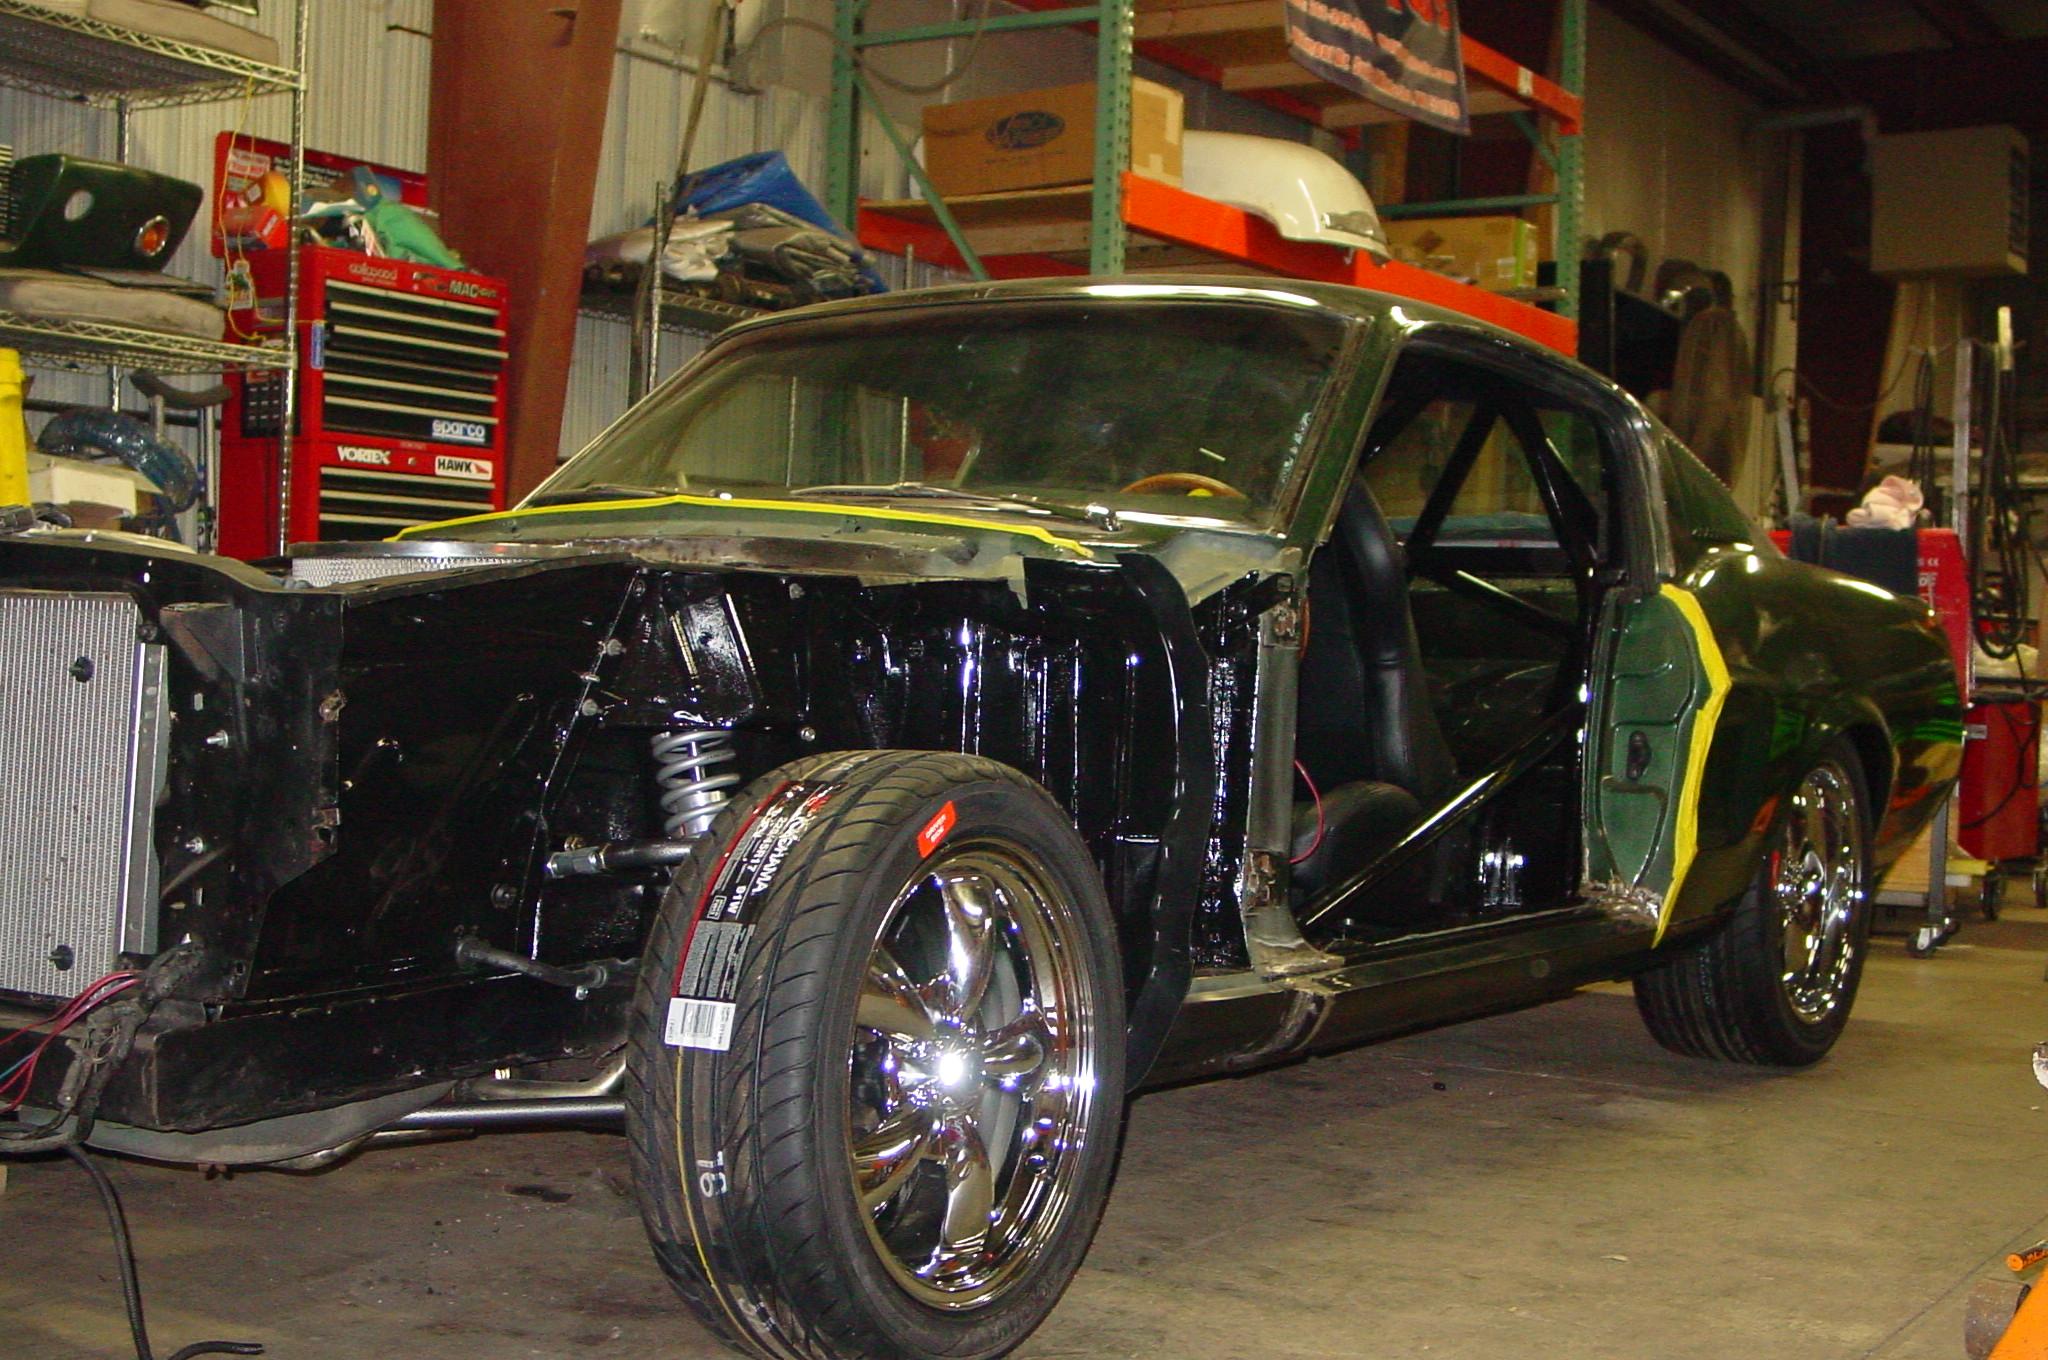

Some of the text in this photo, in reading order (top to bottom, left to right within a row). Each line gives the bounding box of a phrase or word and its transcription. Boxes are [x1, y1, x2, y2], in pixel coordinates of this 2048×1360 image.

[432, 419, 485, 438] sparco
[337, 445, 391, 465] VORTEX
[438, 458, 473, 474] HAWK
